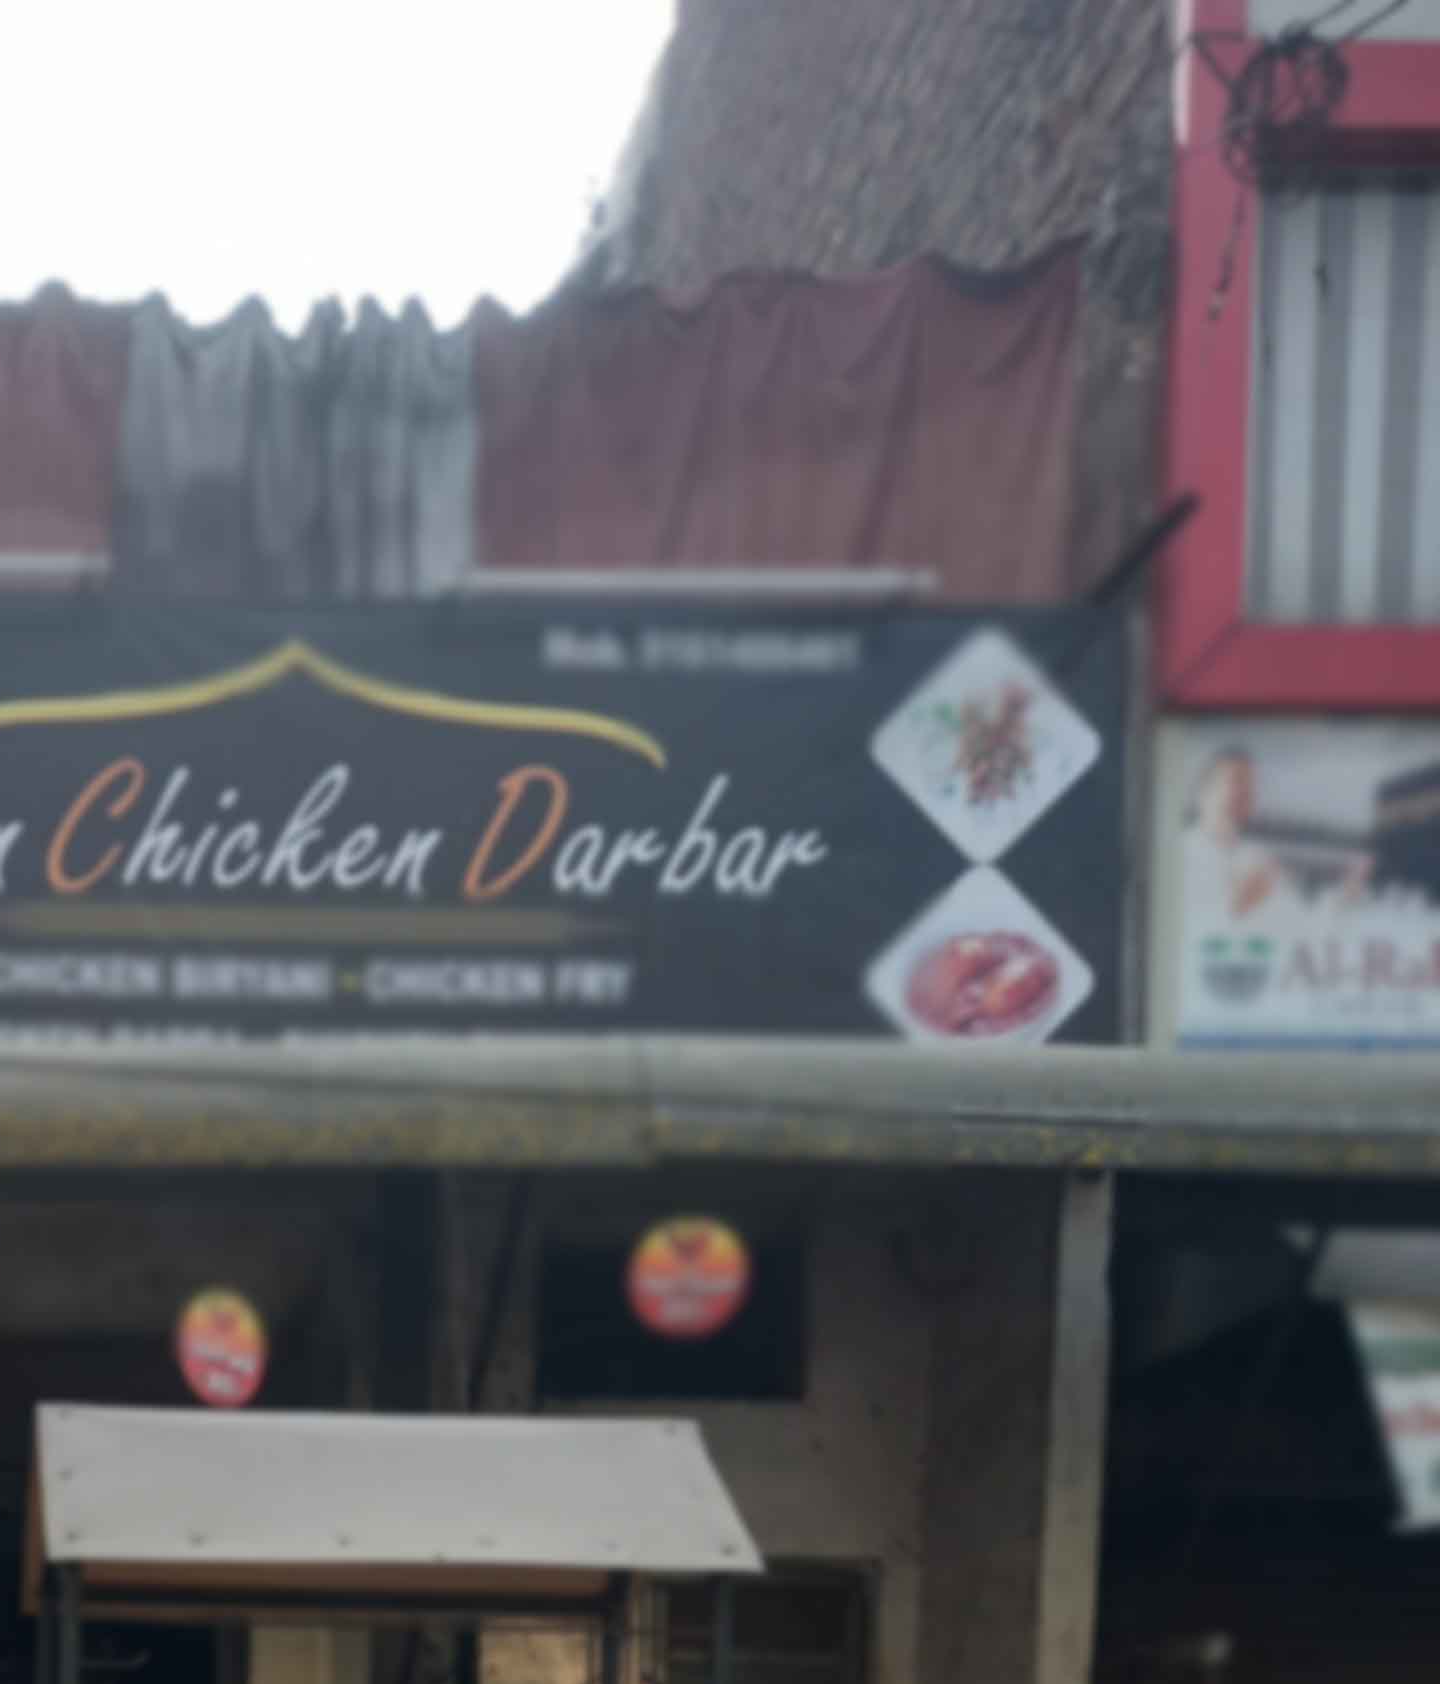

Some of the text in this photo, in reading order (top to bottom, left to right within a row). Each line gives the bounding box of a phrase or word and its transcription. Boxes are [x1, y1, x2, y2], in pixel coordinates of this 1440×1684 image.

[45, 756, 442, 896] Chicken
[464, 766, 828, 900] Darbar
[173, 956, 334, 1001] BIRYANI
[365, 959, 544, 1002] CHICKEN
[556, 960, 631, 1002] FRY
